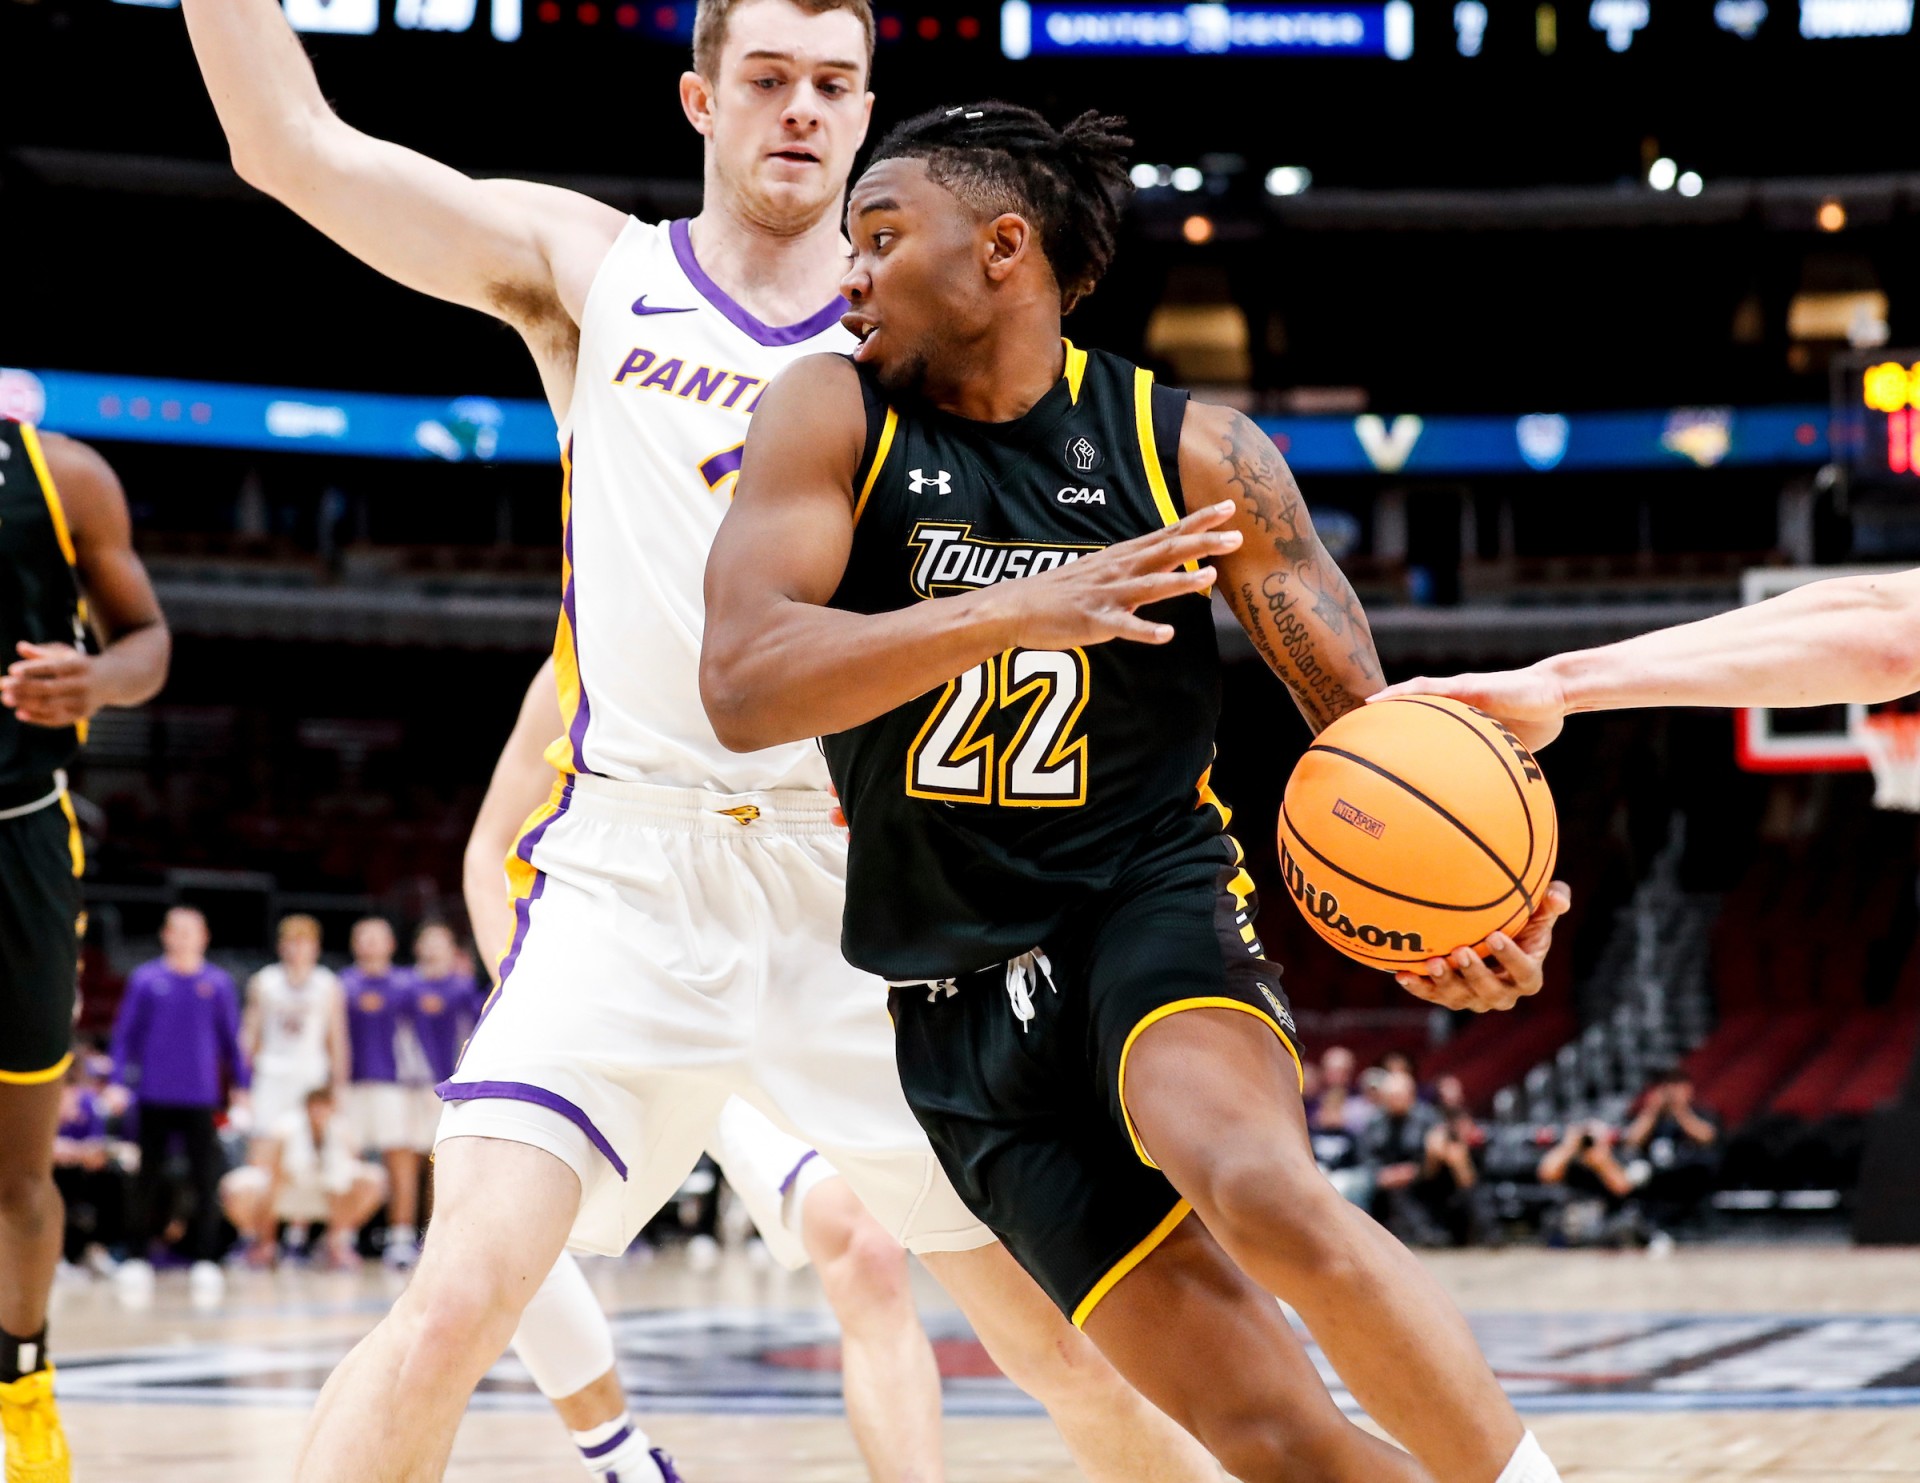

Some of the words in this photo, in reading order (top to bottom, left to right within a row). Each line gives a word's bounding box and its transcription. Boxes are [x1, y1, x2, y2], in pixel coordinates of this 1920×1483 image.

[1056, 486, 1107, 506] CAA
[906, 646, 1091, 808] 22
[1280, 838, 1425, 953] Wilson
